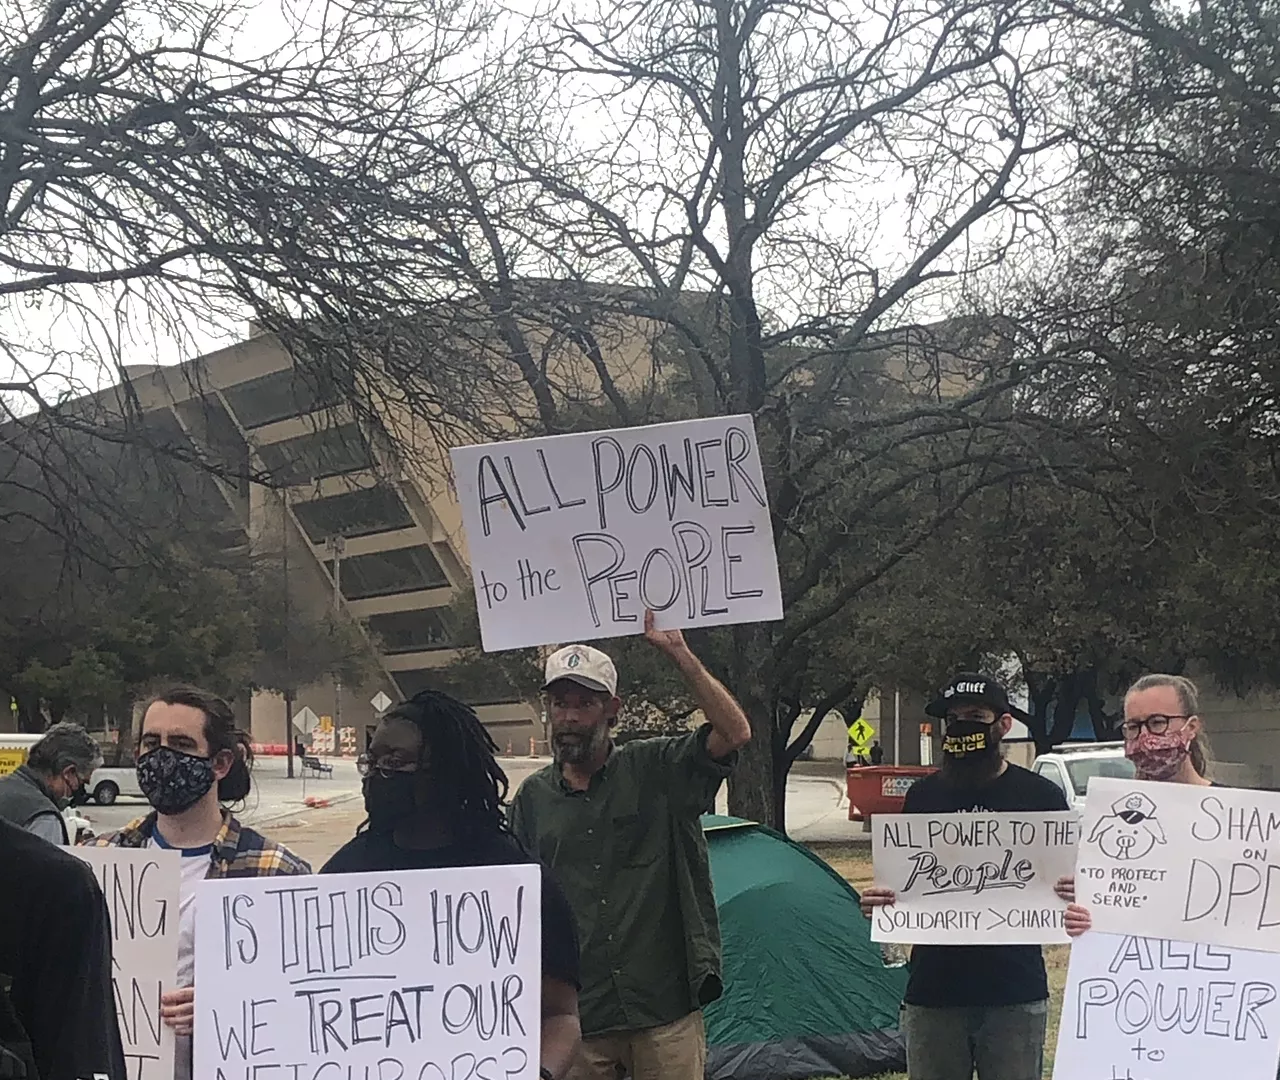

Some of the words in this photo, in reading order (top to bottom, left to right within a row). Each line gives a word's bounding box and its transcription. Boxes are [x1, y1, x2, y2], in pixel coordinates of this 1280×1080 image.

[478, 449, 586, 536] ALL
[592, 427, 766, 529] POWER
[481, 570, 507, 608] to
[517, 559, 561, 600] the
[572, 521, 763, 627] PEOPLE
[884, 822, 922, 848] ALL
[928, 820, 1002, 848] POWER
[1009, 820, 1036, 846] TO
[1043, 821, 1078, 846] THE
[900, 849, 1036, 896] People
[1111, 868, 1167, 881] PROTECT
[1243, 849, 1267, 862] ON
[1109, 881, 1137, 894] AND
[223, 894, 258, 970] IS
[265, 881, 406, 973] THIS
[430, 885, 524, 968] HOW
[877, 904, 981, 933] SOLIDARITY
[1007, 909, 1065, 928] CHARIT
[1109, 935, 1232, 974] ALL
[212, 999, 277, 1061] WE
[294, 985, 434, 1055] TREAT
[442, 975, 526, 1041] OUR
[1076, 977, 1277, 1041] POWER
[1131, 1038, 1165, 1061] to
